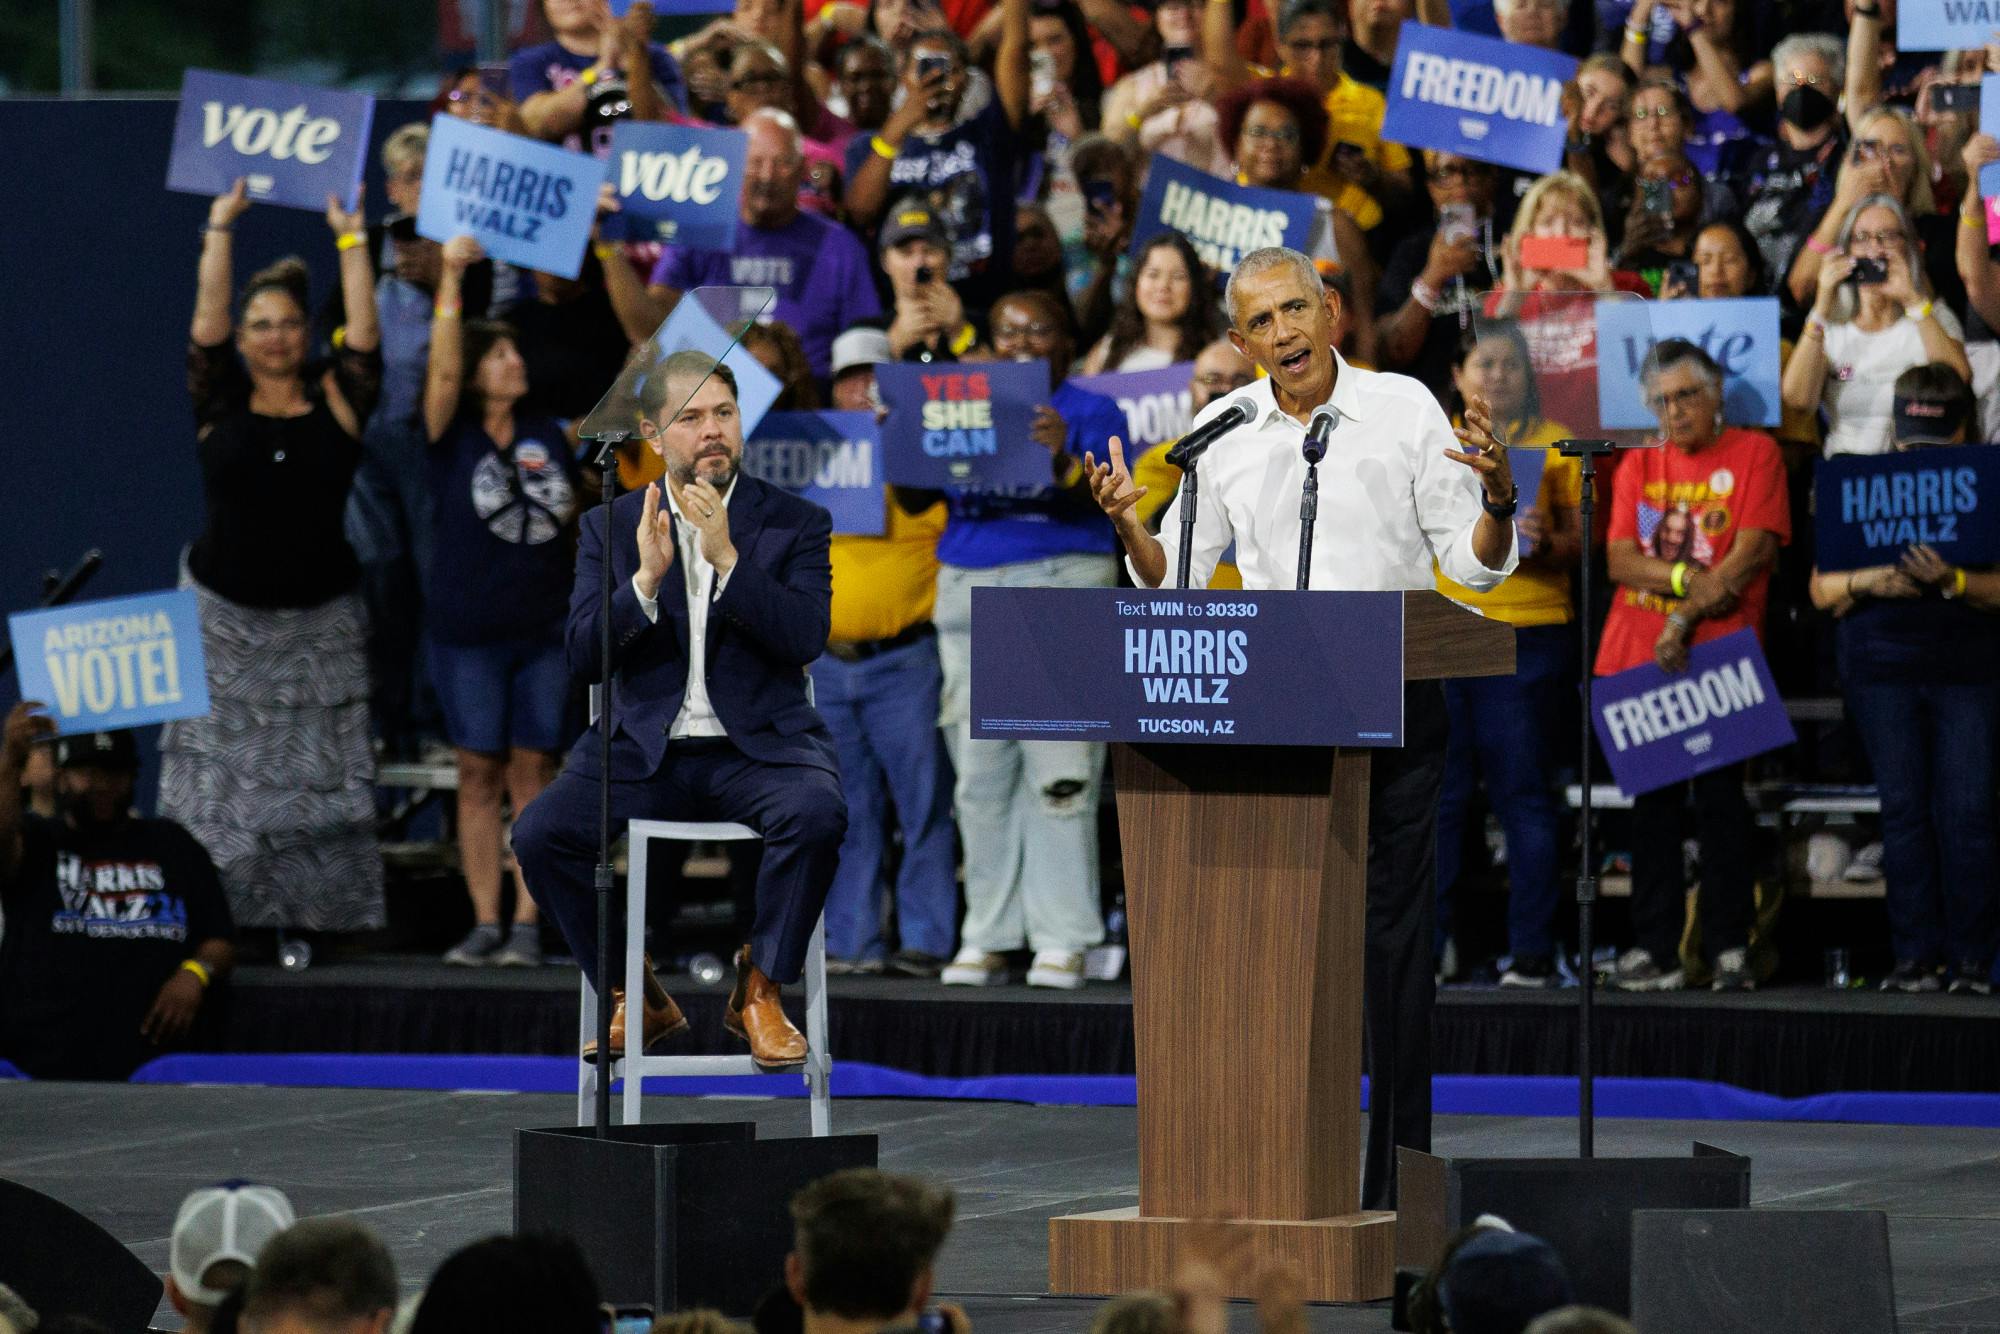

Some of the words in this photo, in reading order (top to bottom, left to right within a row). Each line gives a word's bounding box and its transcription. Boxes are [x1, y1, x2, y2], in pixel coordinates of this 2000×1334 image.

[1944, 0, 2000, 25] WA
[1402, 51, 1562, 127] FREEDOM
[202, 101, 341, 165] vote
[445, 149, 573, 220] HARRIS
[620, 144, 729, 205] vote
[455, 197, 542, 242] WALZ
[1160, 179, 1289, 252] HARRIS
[1622, 320, 1755, 379] vte
[921, 372, 991, 401] YES
[922, 400, 993, 430] SHE
[741, 437, 873, 489] REEDOM
[922, 428, 997, 457] CAN
[1841, 466, 1978, 524] HARRIS
[1862, 513, 1957, 548] WALZ
[44, 609, 173, 654] ARIZONA
[1115, 601, 1147, 616] Text
[1150, 601, 1184, 617] WIN
[1187, 603, 1202, 616] to
[1206, 603, 1258, 617] 30330
[1125, 629, 1248, 675] HARRIS
[45, 638, 182, 718] VOTE!
[1142, 678, 1229, 704] WALZ
[1138, 719, 1209, 736] TUCSON,
[1213, 720, 1235, 734] AZ
[1602, 657, 1766, 752] FREEDOM
